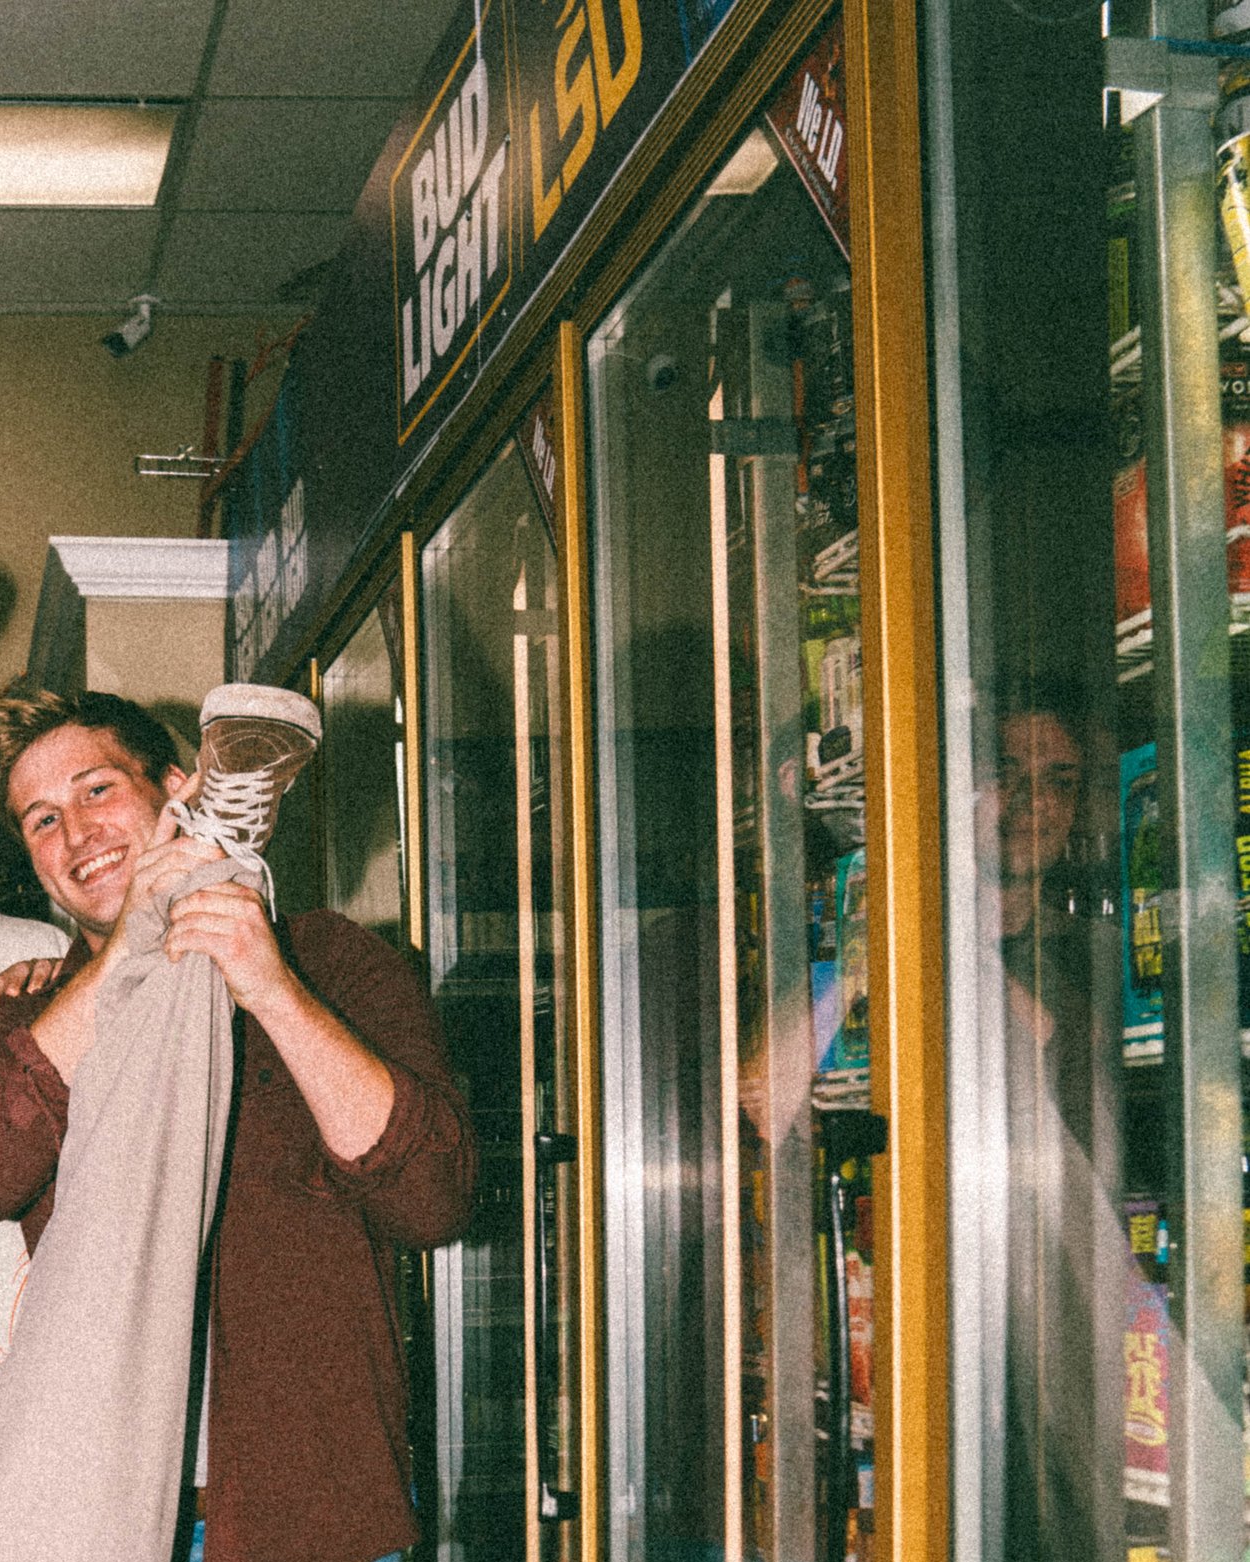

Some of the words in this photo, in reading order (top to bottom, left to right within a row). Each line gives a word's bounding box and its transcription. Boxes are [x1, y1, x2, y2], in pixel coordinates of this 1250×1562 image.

[412, 58, 488, 274] BUD
[797, 71, 822, 154] We
[402, 145, 505, 405] LIGHT
